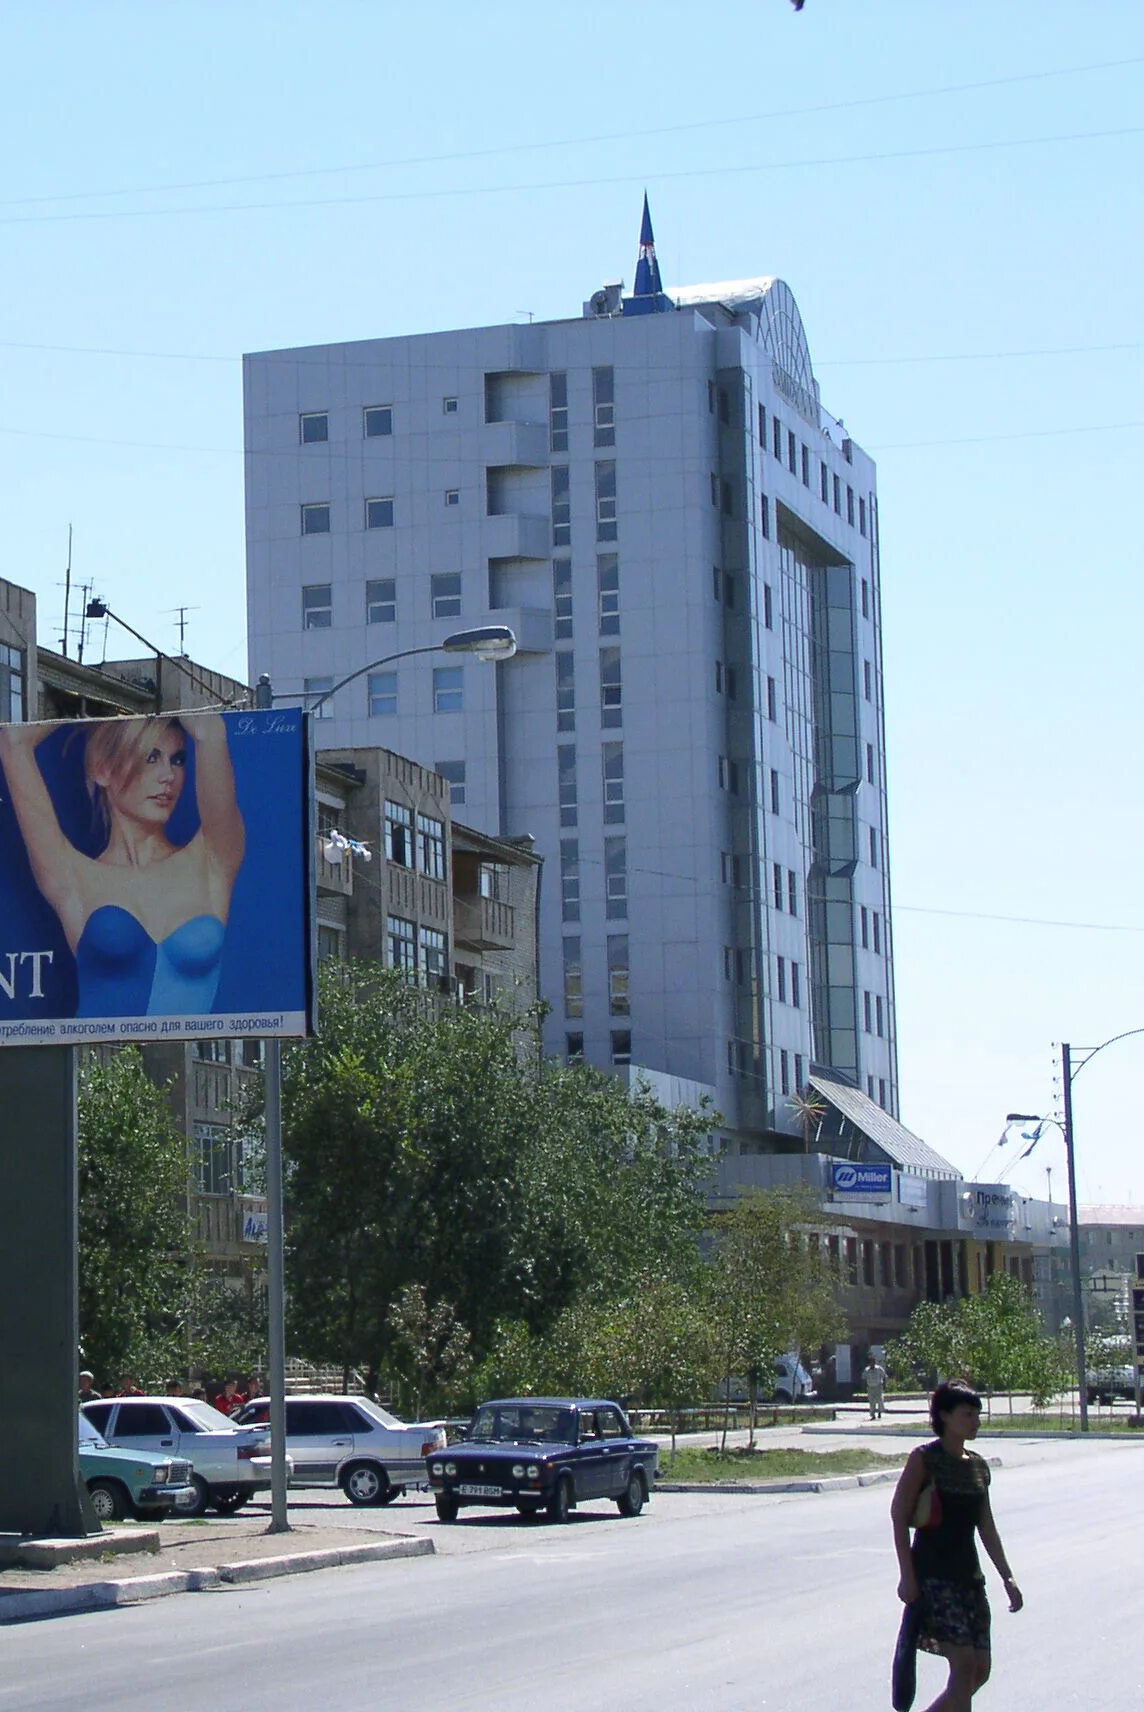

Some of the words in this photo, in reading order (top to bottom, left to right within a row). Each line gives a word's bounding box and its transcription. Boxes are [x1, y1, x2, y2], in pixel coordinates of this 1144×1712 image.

[60, 1023, 115, 1036] алкоголем
[120, 1021, 157, 1034] опасно
[161, 1021, 181, 1034] для
[185, 1020, 224, 1032] вашего
[230, 1015, 284, 1031] здоровья!
[857, 1171, 888, 1183] Miller
